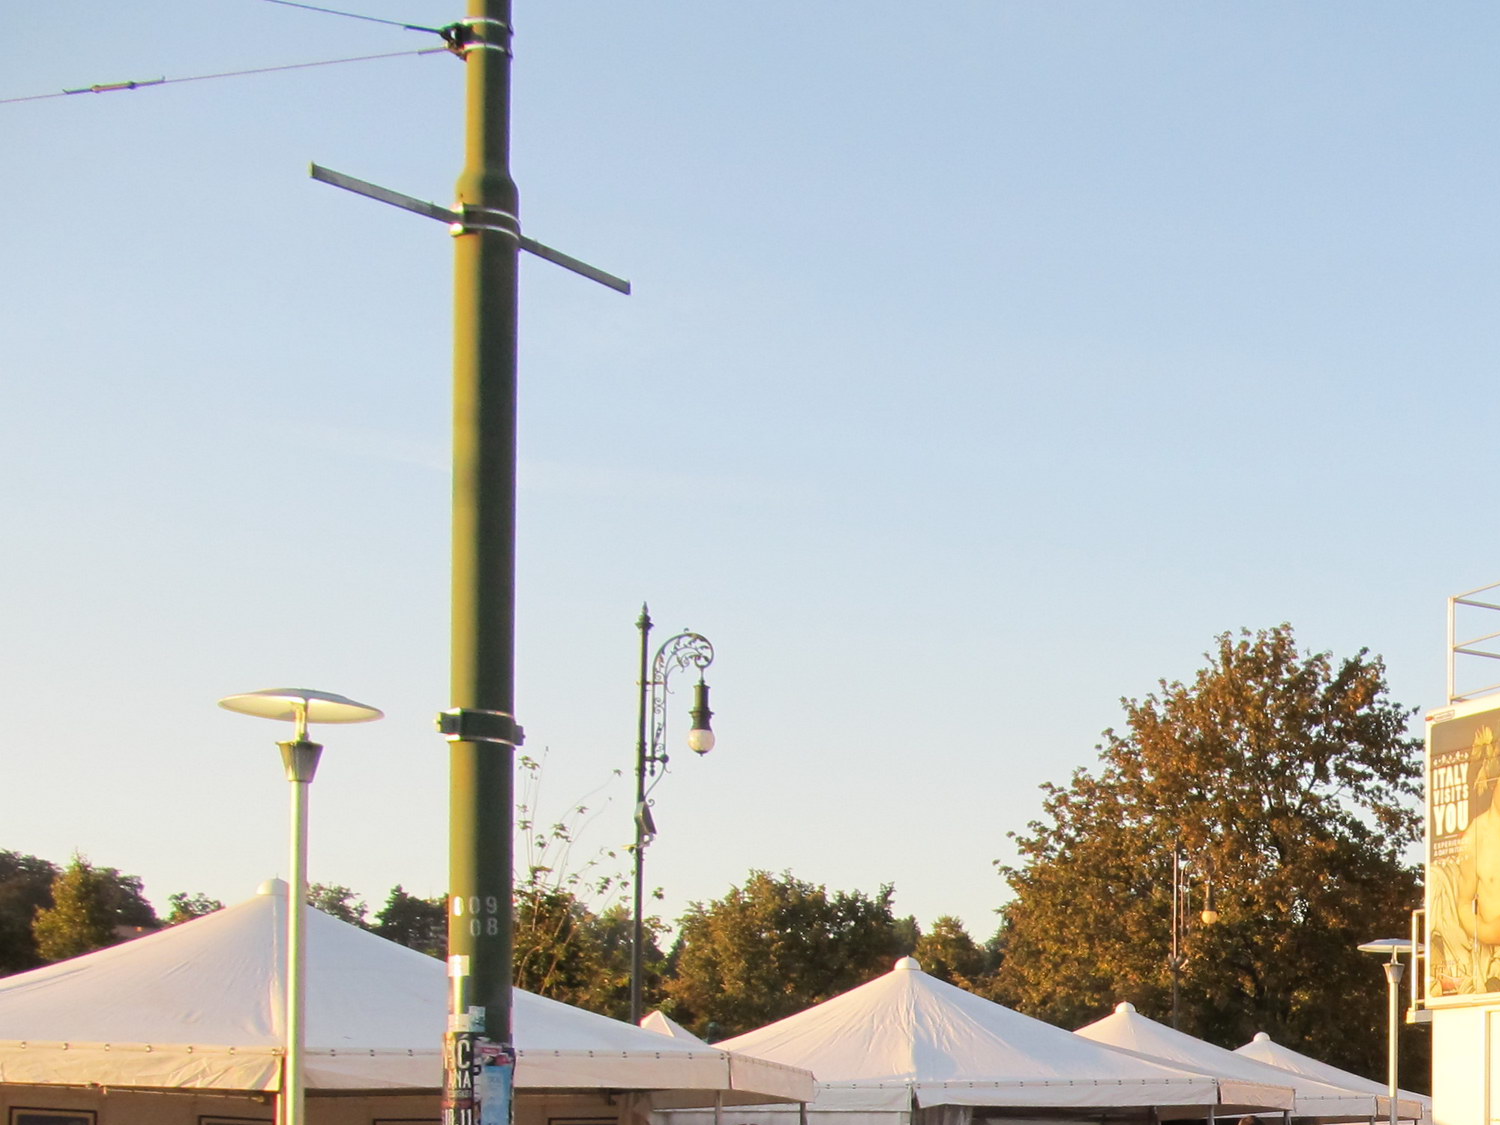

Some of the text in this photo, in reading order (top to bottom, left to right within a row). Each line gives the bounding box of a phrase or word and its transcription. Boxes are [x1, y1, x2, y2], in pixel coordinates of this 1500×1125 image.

[1433, 762, 1469, 790] ITALY
[1433, 784, 1469, 806] VISITS
[1433, 800, 1469, 836] YOU
[469, 918, 498, 936] 08
